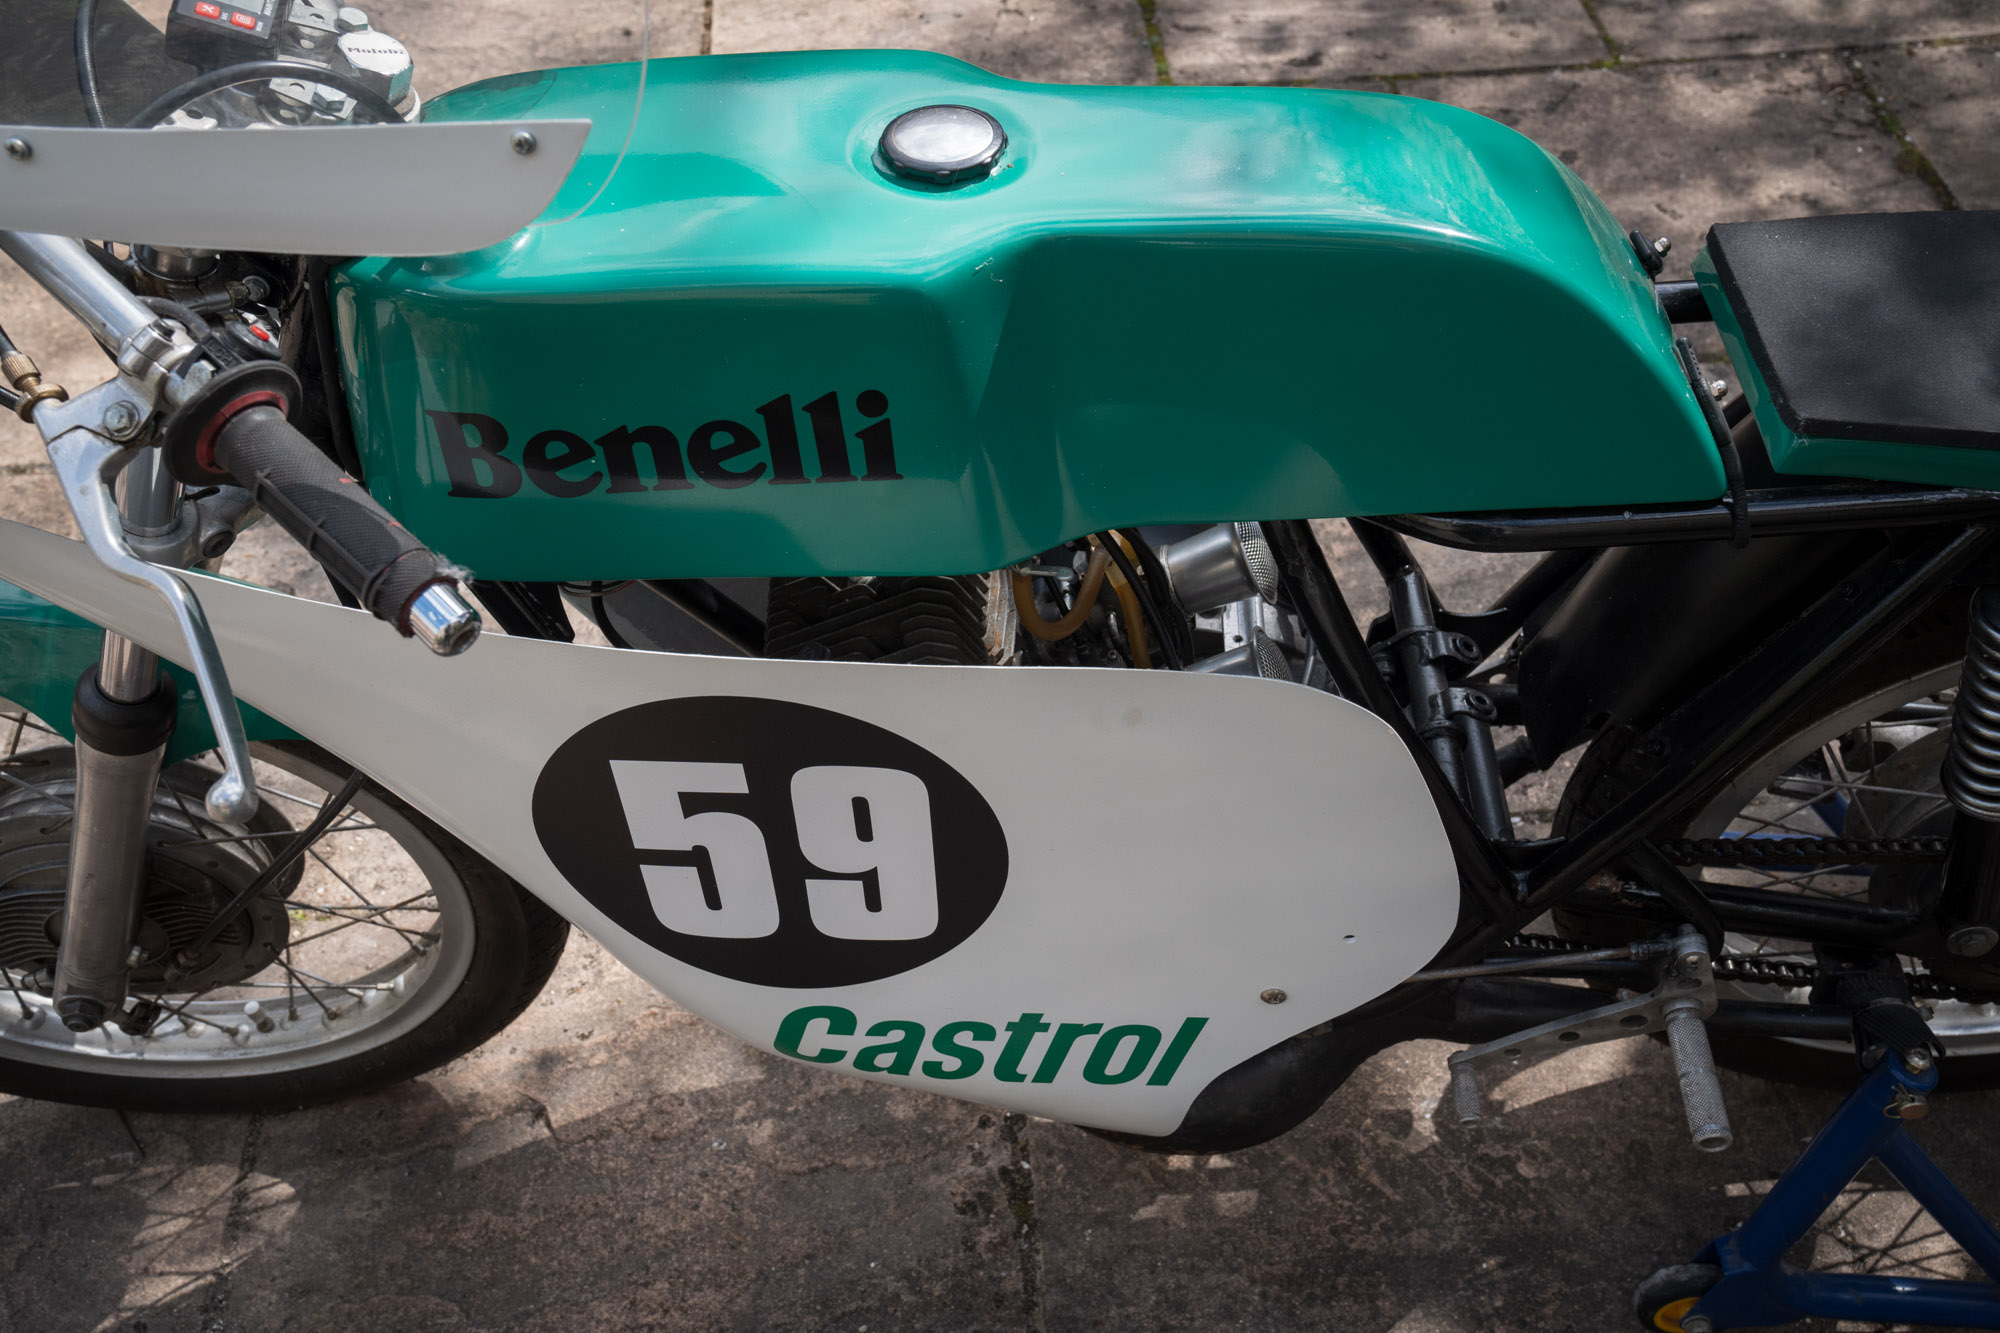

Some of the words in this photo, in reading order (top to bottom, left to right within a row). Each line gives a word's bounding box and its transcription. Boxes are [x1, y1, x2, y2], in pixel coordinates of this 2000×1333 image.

[424, 388, 904, 499] Benelli
[608, 759, 939, 941] 59
[772, 1004, 1210, 1086] Castrol
